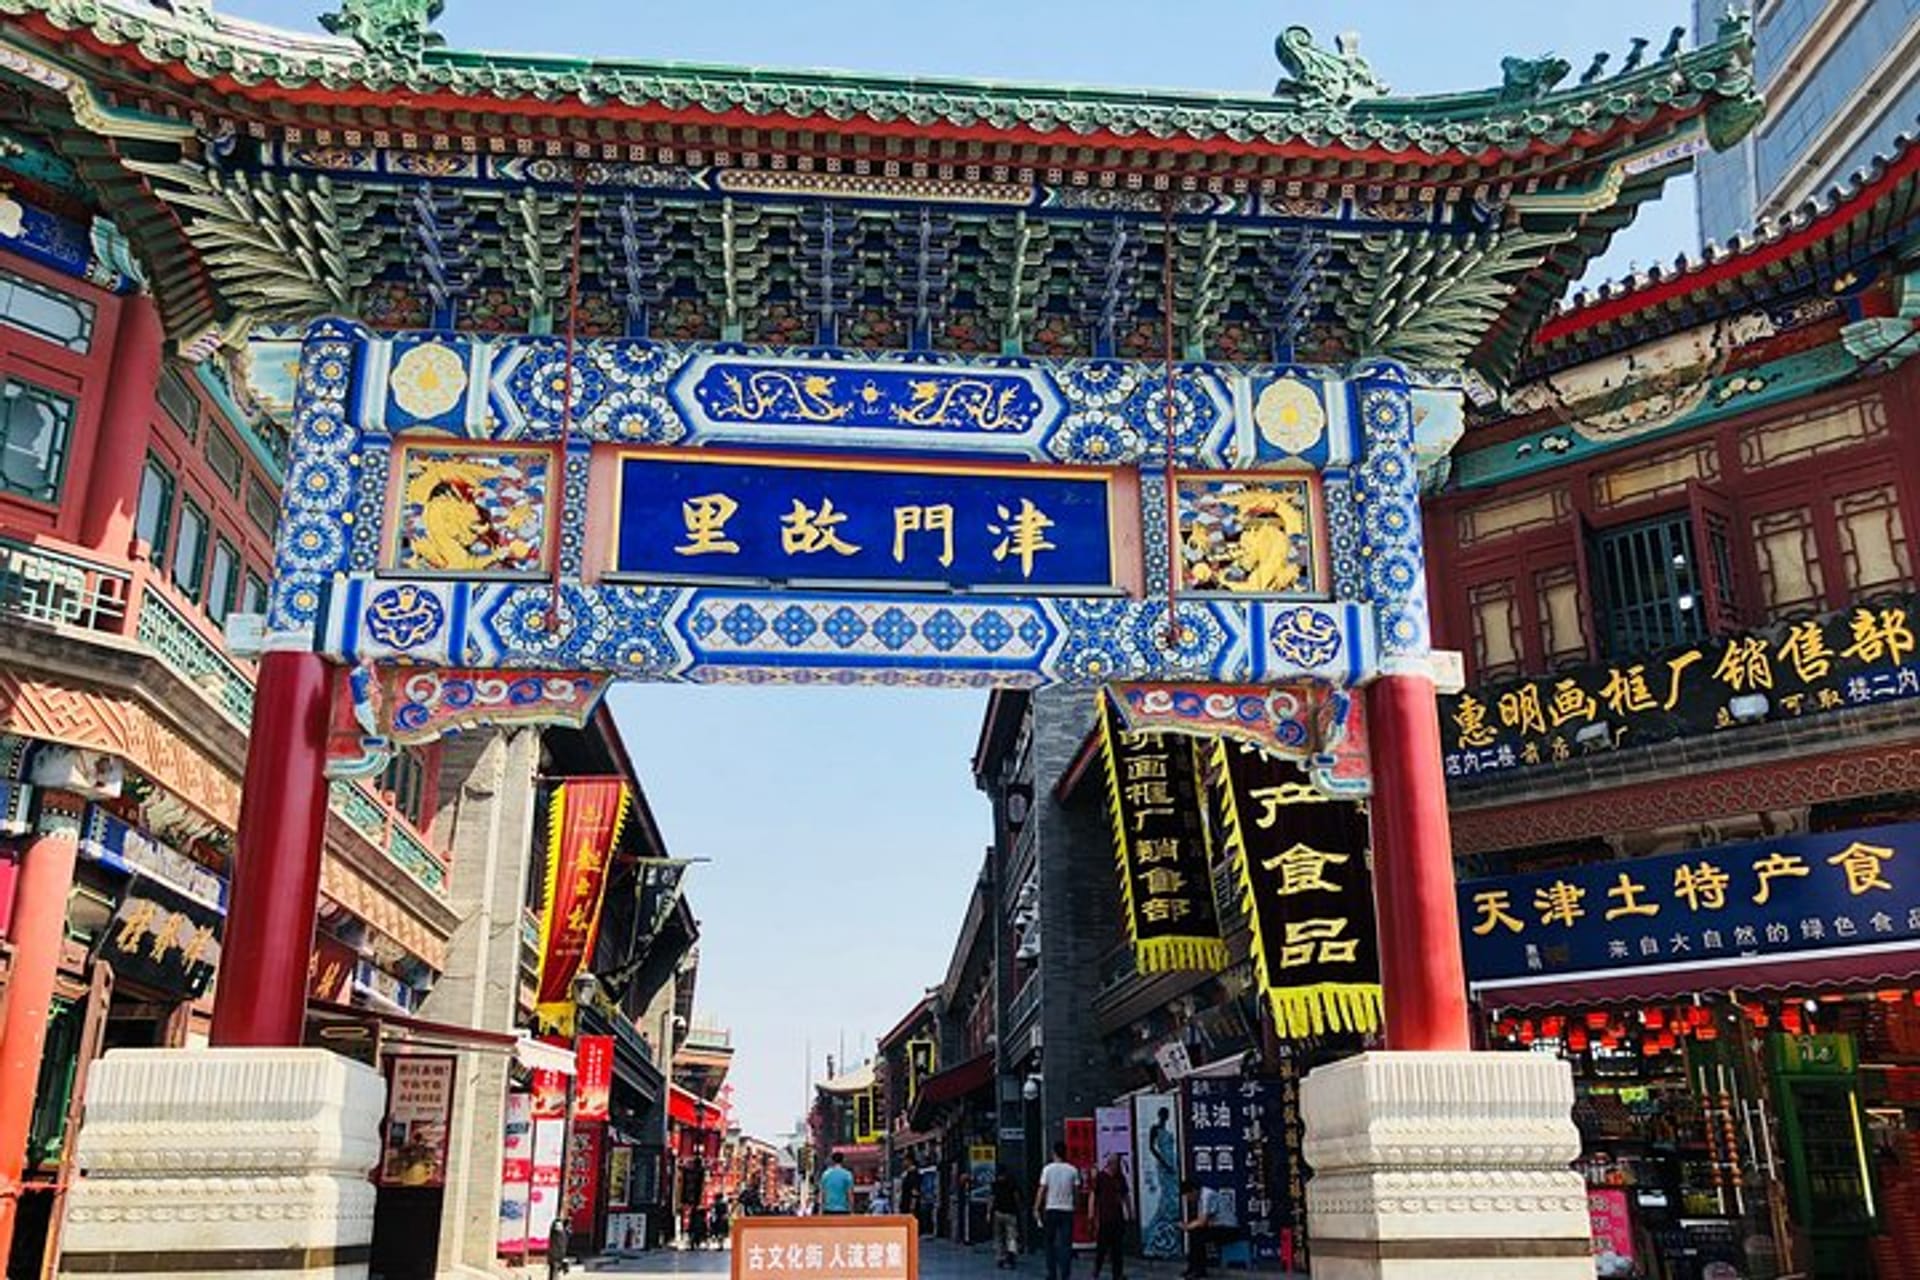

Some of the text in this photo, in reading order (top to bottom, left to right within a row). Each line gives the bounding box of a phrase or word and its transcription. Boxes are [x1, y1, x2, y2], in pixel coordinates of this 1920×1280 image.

[1451, 607, 1916, 749] 惠明画框厂销售部
[1472, 841, 1896, 936] 天津土特产食
[748, 1243, 824, 1271] 古文化街
